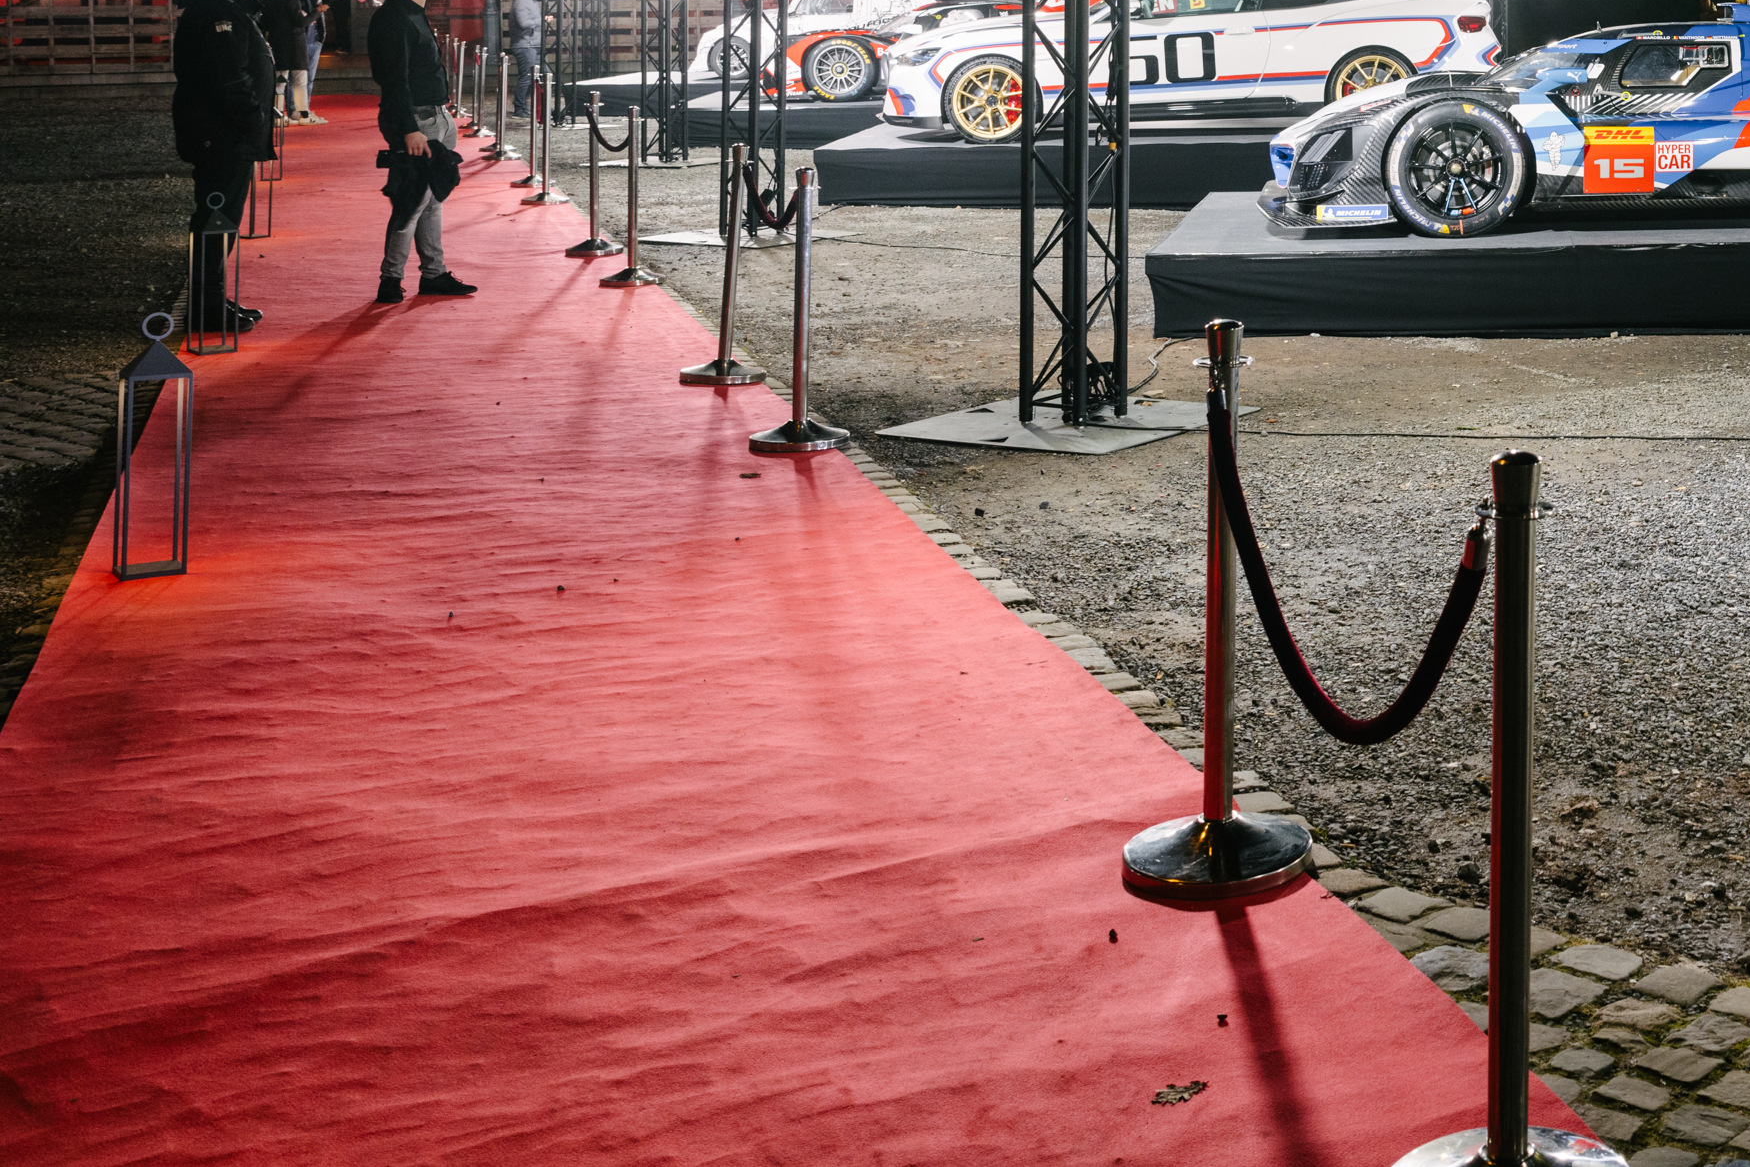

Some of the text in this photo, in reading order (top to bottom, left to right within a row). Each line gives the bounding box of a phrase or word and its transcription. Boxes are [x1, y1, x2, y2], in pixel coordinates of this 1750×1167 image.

[831, 39, 871, 64] GOODYEAR
[1481, 110, 1518, 150] MICHELIN
[1593, 129, 1646, 140] DHL
[1657, 144, 1691, 154] HYPER
[1593, 158, 1645, 179] 15
[1657, 154, 1691, 170] CAR
[1335, 209, 1382, 217] MICHELIN
[1394, 189, 1431, 227] MICHELIN
